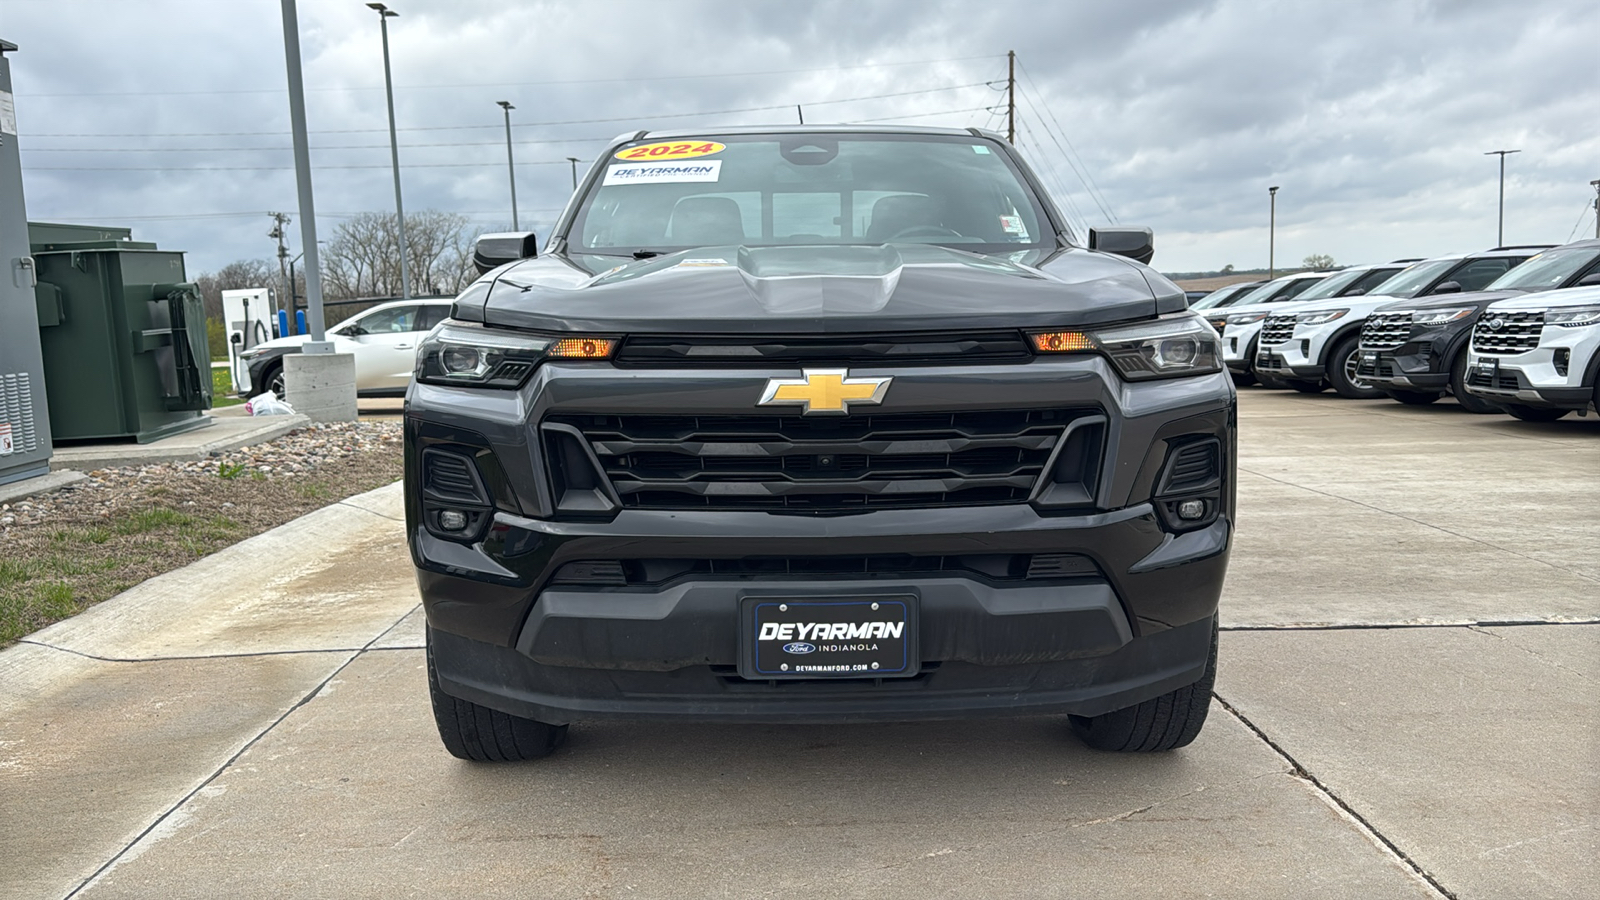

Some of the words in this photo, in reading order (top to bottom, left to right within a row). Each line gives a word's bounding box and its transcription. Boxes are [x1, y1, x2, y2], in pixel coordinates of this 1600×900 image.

[625, 143, 715, 159] 2024
[614, 166, 714, 176] DEYARMAN
[758, 621, 905, 641] DEYARMAN
[818, 643, 879, 652] INDIANOLA
[795, 664, 868, 672] DEYARMANFORD.COM
